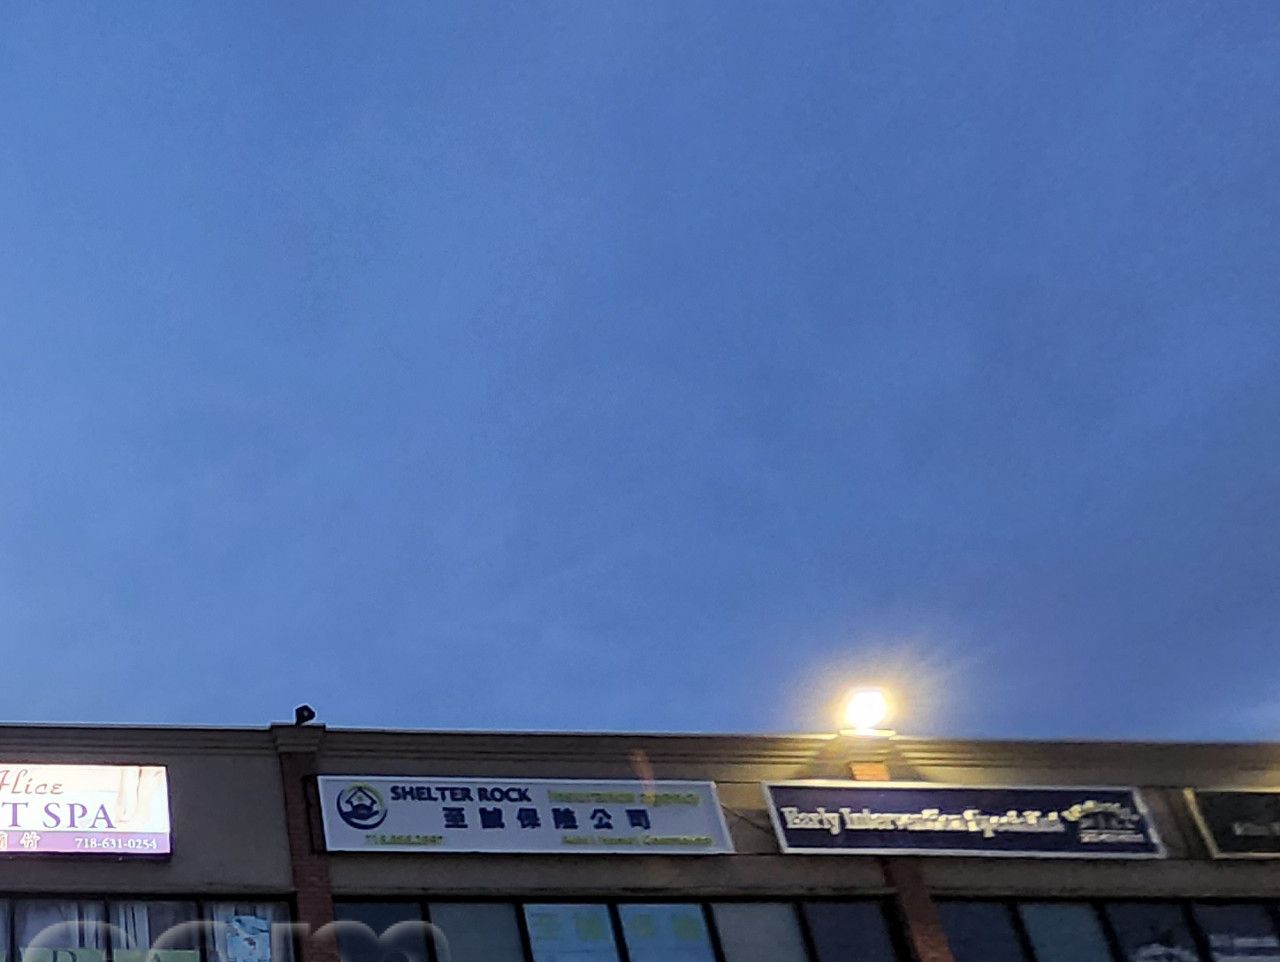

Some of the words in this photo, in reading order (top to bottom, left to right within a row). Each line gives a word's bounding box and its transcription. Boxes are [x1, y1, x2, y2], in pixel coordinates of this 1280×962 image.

[389, 785, 475, 802] SHELTER
[477, 787, 532, 803] ROCK
[41, 802, 117, 829] SPA
[74, 835, 158, 851] 718-631-0254
